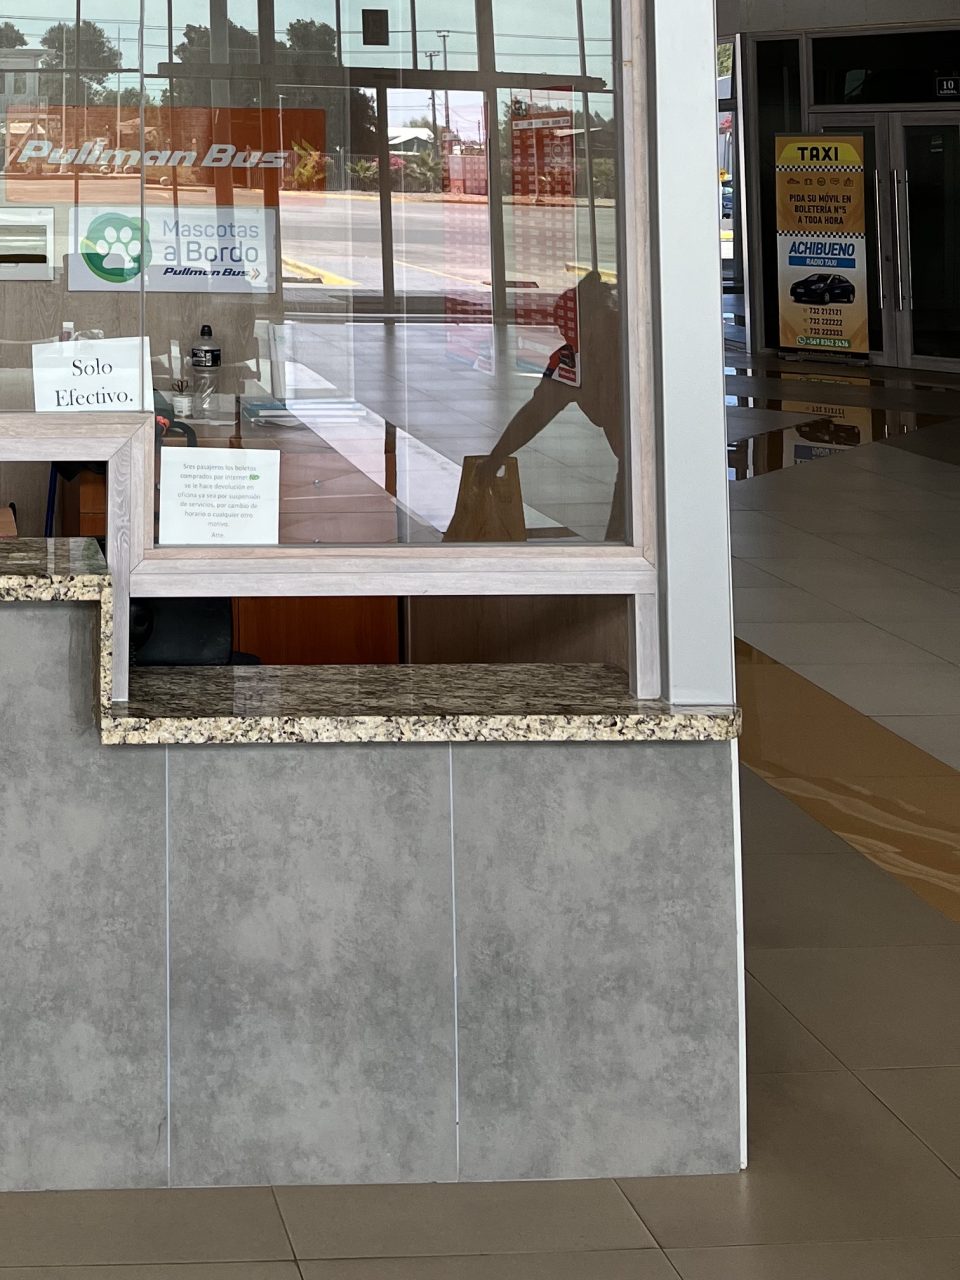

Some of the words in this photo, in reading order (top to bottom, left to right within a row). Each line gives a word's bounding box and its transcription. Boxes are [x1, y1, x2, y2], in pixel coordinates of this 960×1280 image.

[943, 80, 954, 89] 10
[17, 139, 198, 167] Pullman
[201, 143, 289, 168] Bus
[797, 147, 839, 161] TAXI
[789, 194, 805, 202] PIDA
[807, 194, 817, 203] SU
[842, 195, 852, 203] EN
[797, 216, 803, 224] A
[804, 216, 823, 224] TODA
[824, 216, 844, 225] HORA
[163, 220, 259, 238] Mascotas
[164, 245, 177, 262] a
[186, 240, 259, 263] Bordo
[789, 241, 855, 257] ACHIBUENO
[806, 258, 824, 266] RADIO
[72, 358, 113, 377] Solo
[54, 387, 133, 408] Efectivo.
[197, 464, 224, 472] pasajeros
[180, 473, 213, 481] comprados
